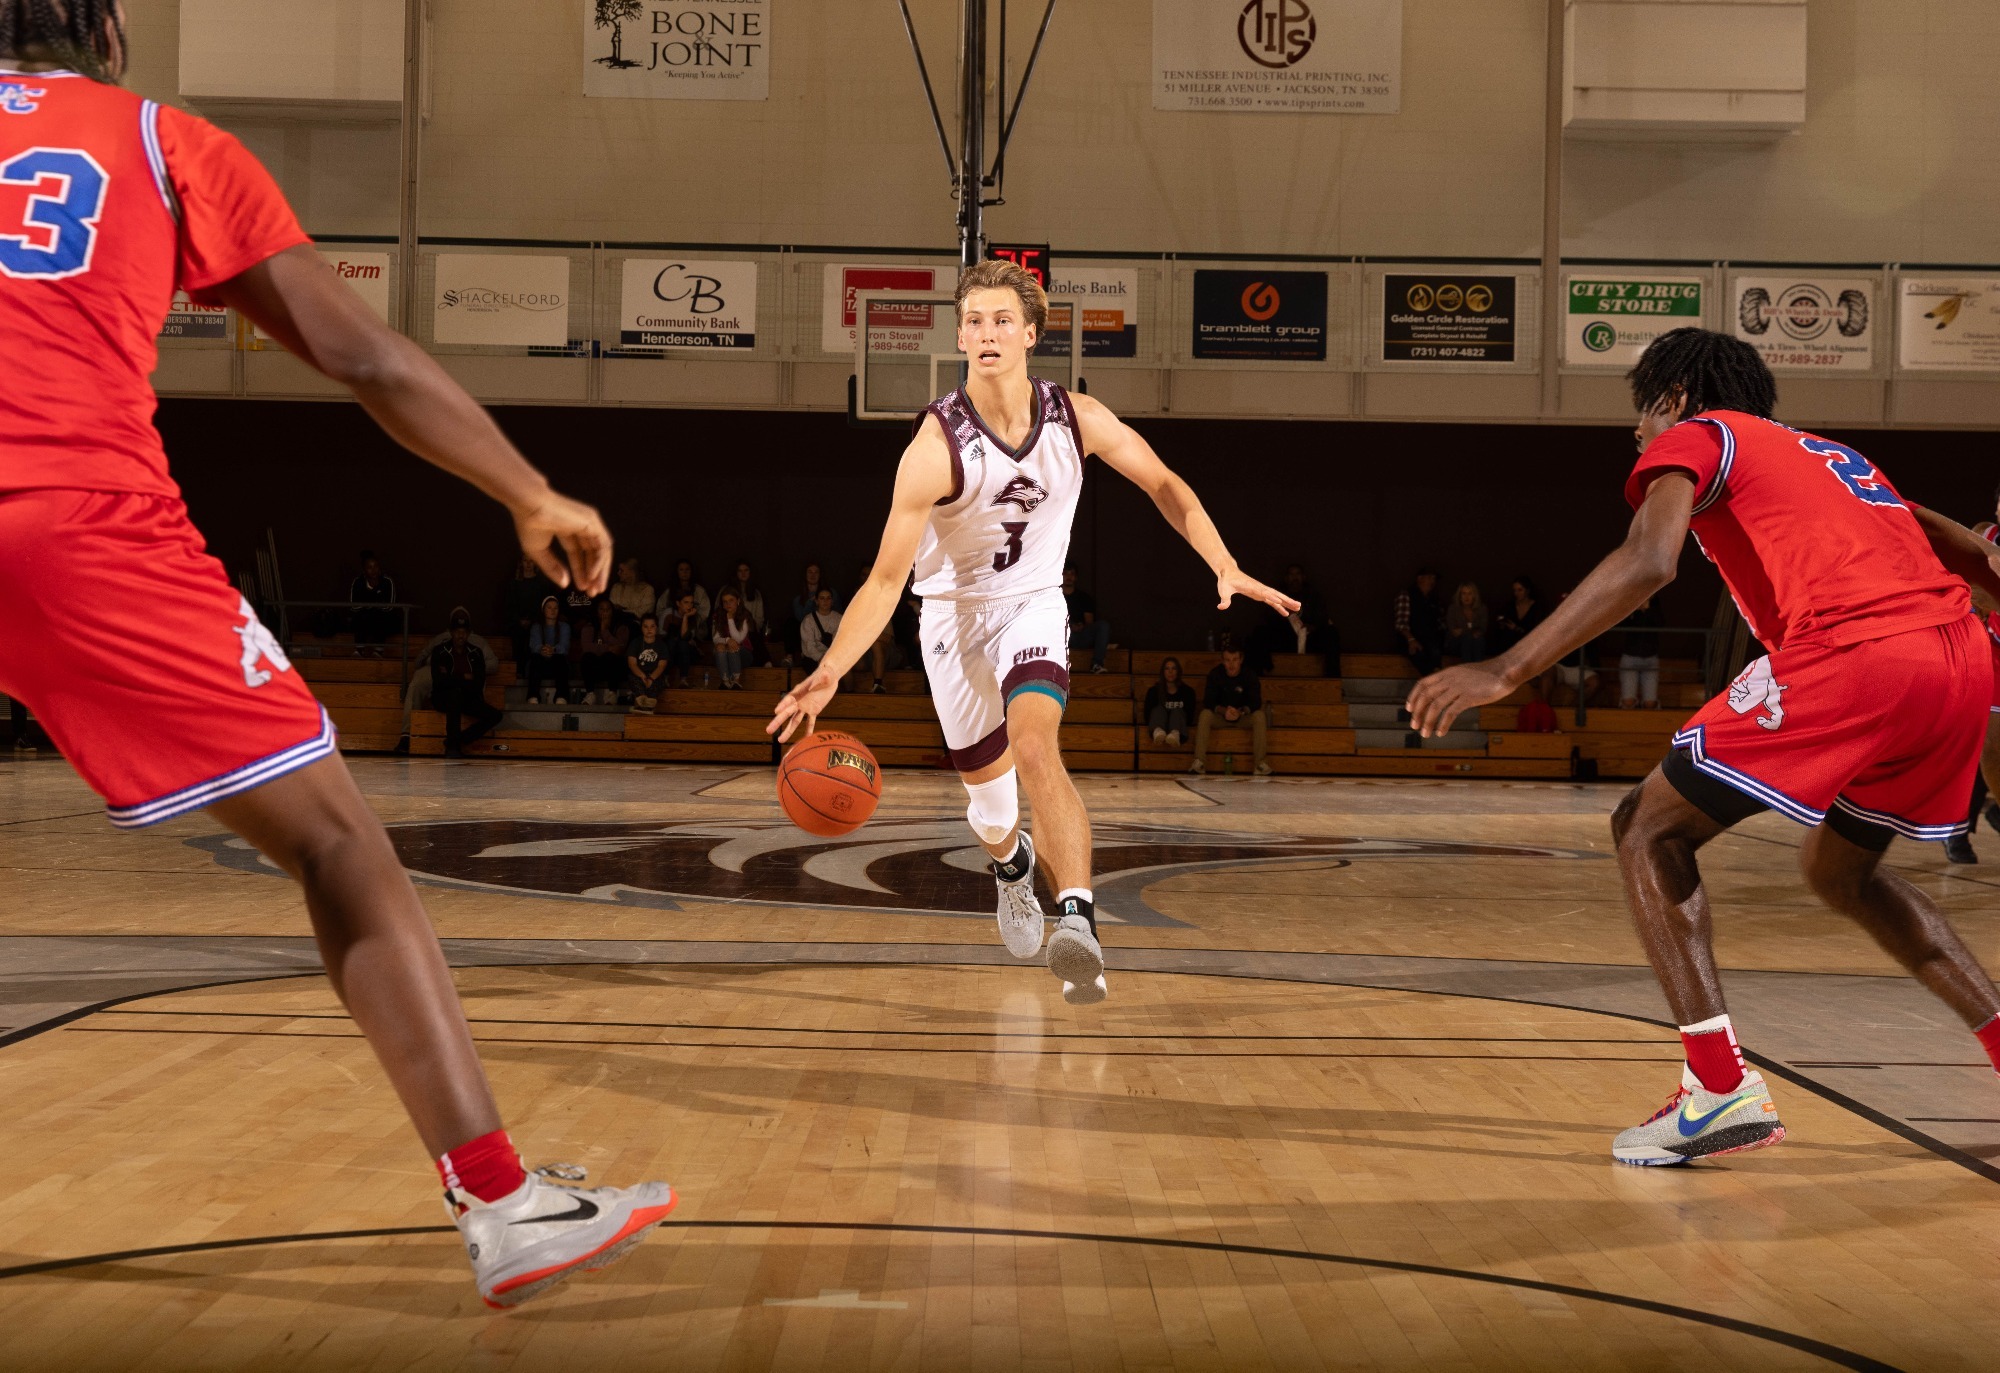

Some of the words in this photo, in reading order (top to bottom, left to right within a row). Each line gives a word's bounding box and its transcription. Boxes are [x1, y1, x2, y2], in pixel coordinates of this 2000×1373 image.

[651, 11, 762, 36] BONE
[692, 31, 714, 51] &
[647, 42, 762, 70] JOINT
[701, 70, 716, 79] You
[1162, 71, 1228, 80] TENNESSEE
[1231, 71, 1303, 81] INDUSTRIAL
[1305, 72, 1365, 82] PRINTING,
[1367, 73, 1391, 82] INC.
[1164, 84, 1176, 92] 51
[1178, 84, 1222, 93] MILLER
[1225, 84, 1271, 93] AVENUE
[1283, 85, 1339, 95] JACKSON,
[1342, 86, 1357, 94] TN
[1360, 86, 1390, 95] 38305
[1188, 97, 1253, 106] 731.668.3500
[1265, 99, 1365, 109] www.tipsprints.com
[0, 147, 110, 280] 3
[337, 261, 380, 278] Farm
[653, 263, 725, 314] CB
[1090, 281, 1127, 294] Bank
[1572, 283, 1633, 297] CITY
[1636, 284, 1698, 298] DRUG
[438, 290, 560, 312] SHACKELFORD
[1597, 299, 1672, 313] STORE
[636, 315, 708, 332] Community
[710, 317, 741, 330] Bank
[1391, 314, 1425, 323] Golden
[1426, 315, 1453, 324] Circle
[1455, 315, 1509, 325] Restoration
[889, 331, 924, 341] Stovall
[1199, 324, 1271, 333] bramblett
[1275, 326, 1320, 336] group
[641, 332, 714, 347] Henderson,
[717, 334, 735, 346] TN
[1411, 347, 1437, 357] (731)
[1438, 348, 1486, 357] 407-4822
[1764, 353, 1843, 364] 731-989-2837
[1798, 437, 1910, 512] 2
[992, 521, 1029, 573] 3
[1013, 646, 1049, 665] FHU
